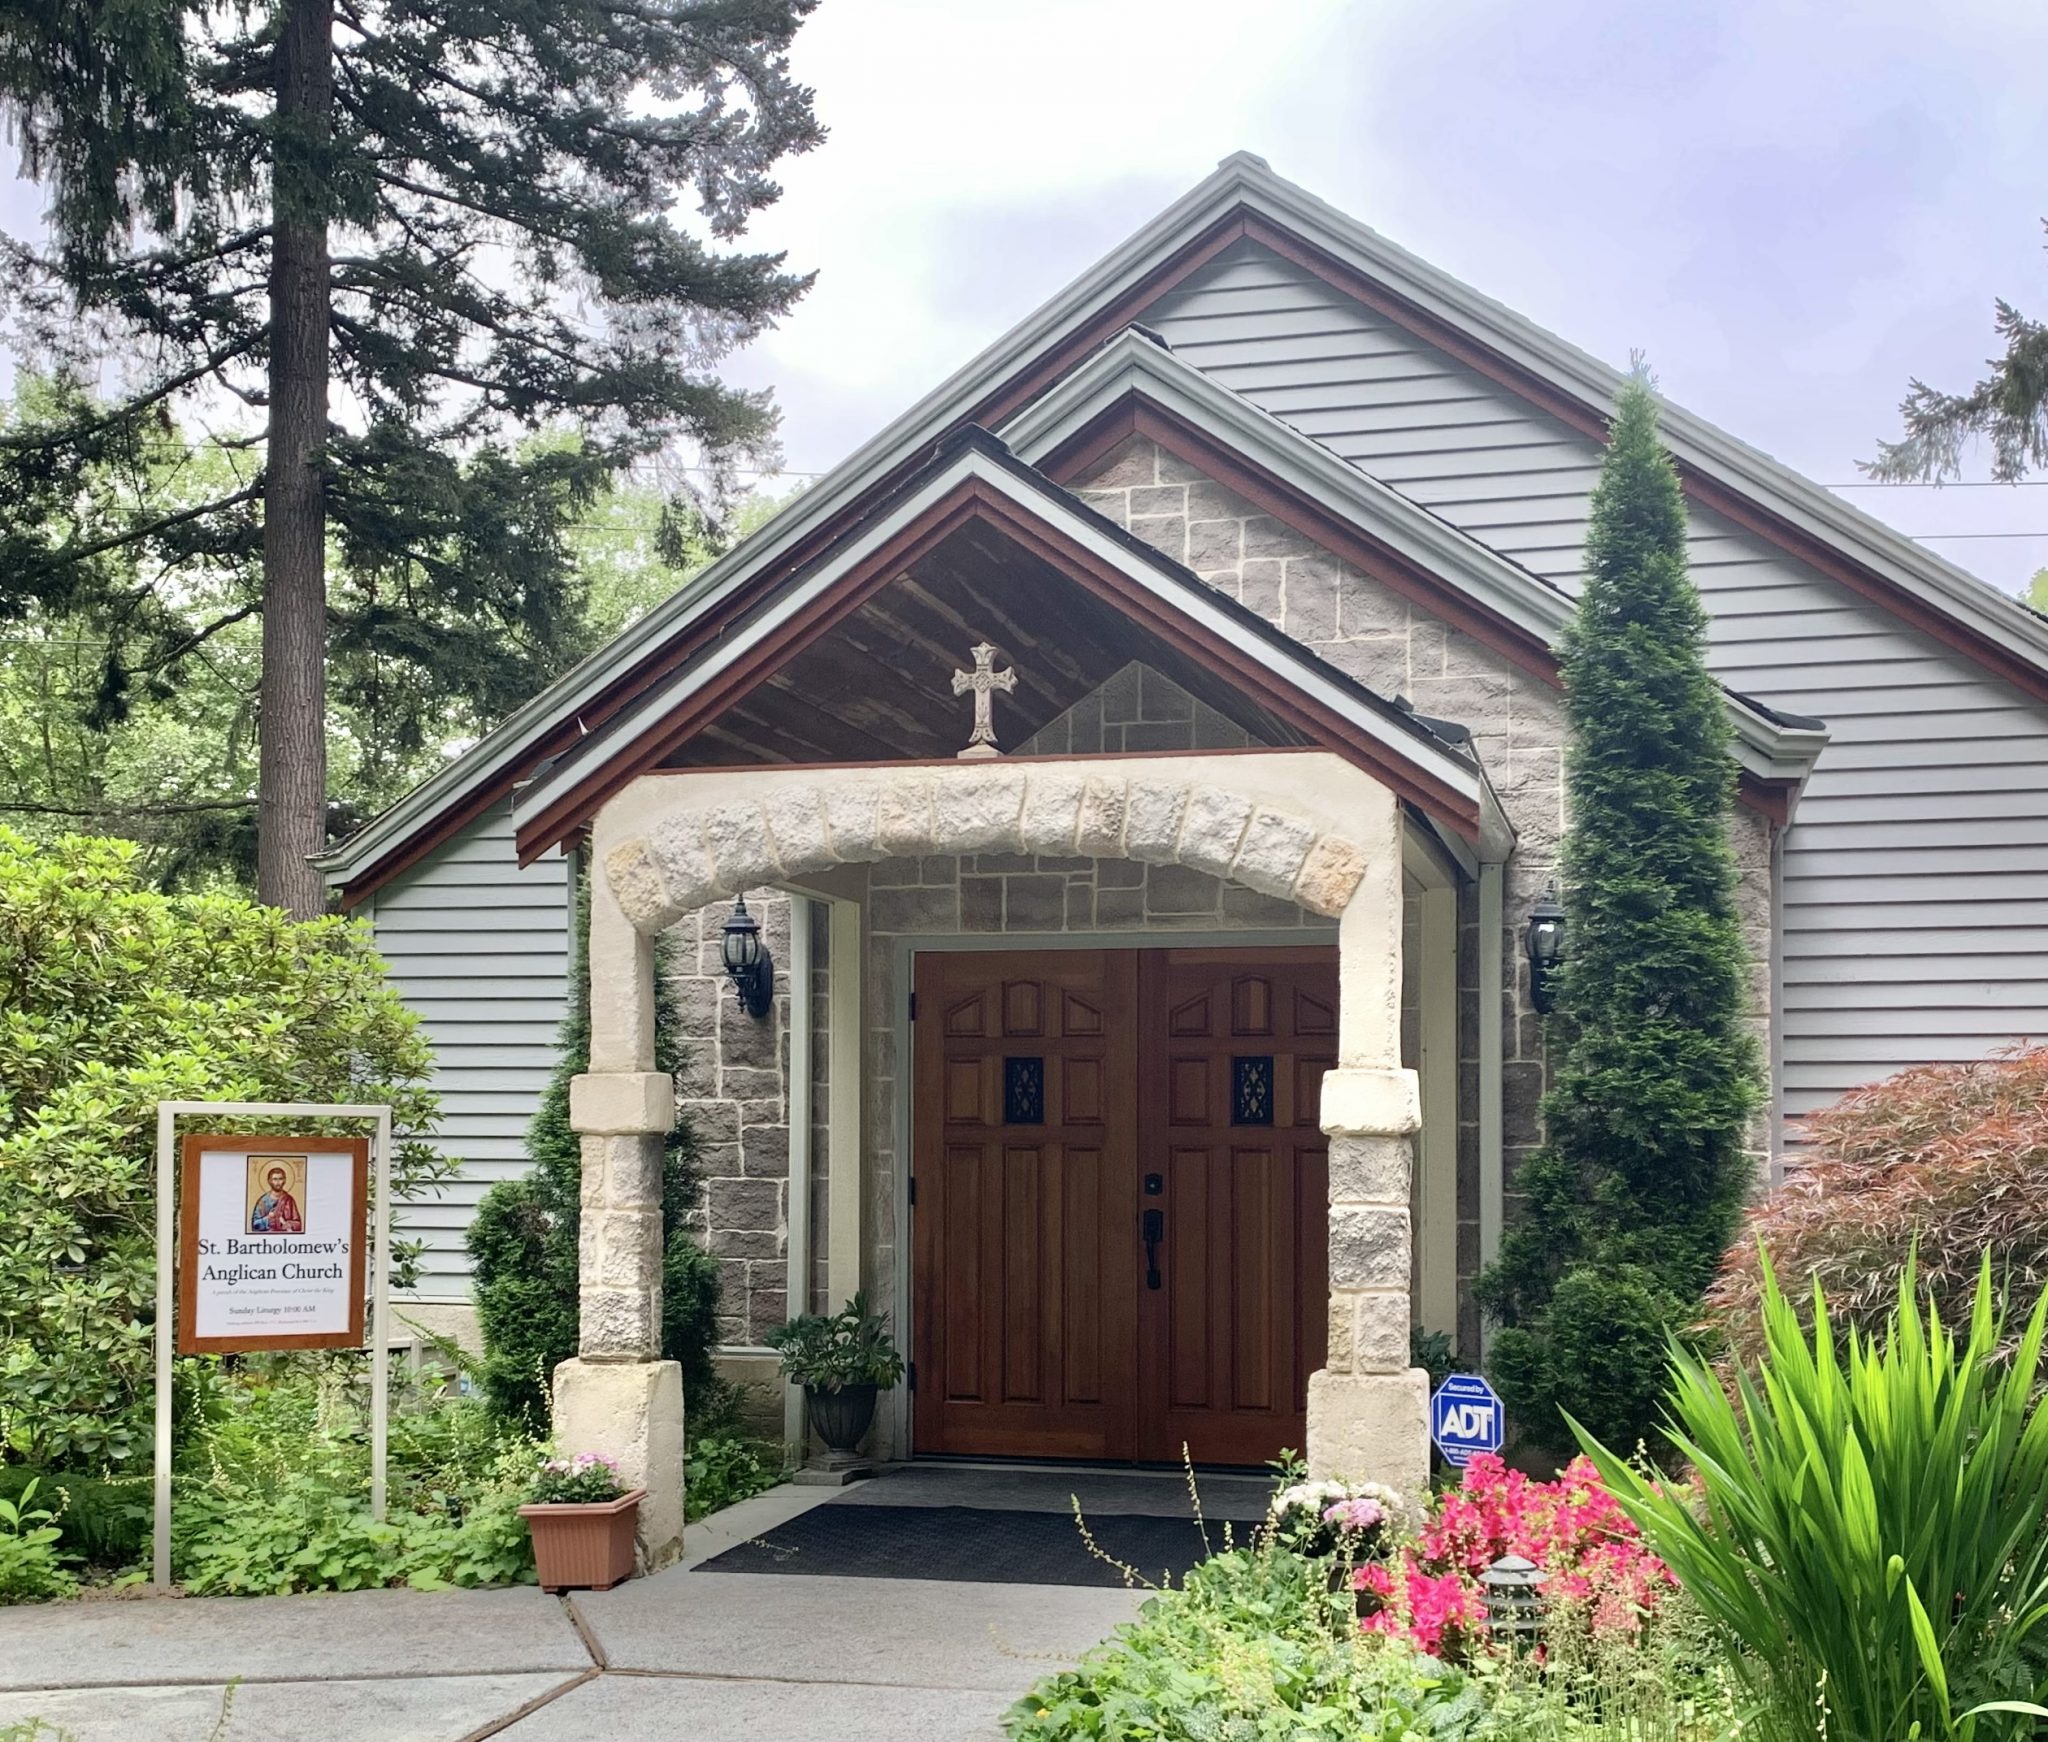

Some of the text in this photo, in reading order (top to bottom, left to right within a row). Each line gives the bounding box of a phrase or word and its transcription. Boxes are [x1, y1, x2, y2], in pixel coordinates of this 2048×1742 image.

[198, 1238, 349, 1255] St. Bartholomew’s
[203, 1263, 343, 1285] Anglican Church
[229, 1306, 255, 1316] Sunday
[256, 1306, 281, 1315] Liturgy
[303, 1305, 316, 1313] AM
[1448, 1382, 1484, 1395] Secured by
[1440, 1404, 1493, 1441] ADT
